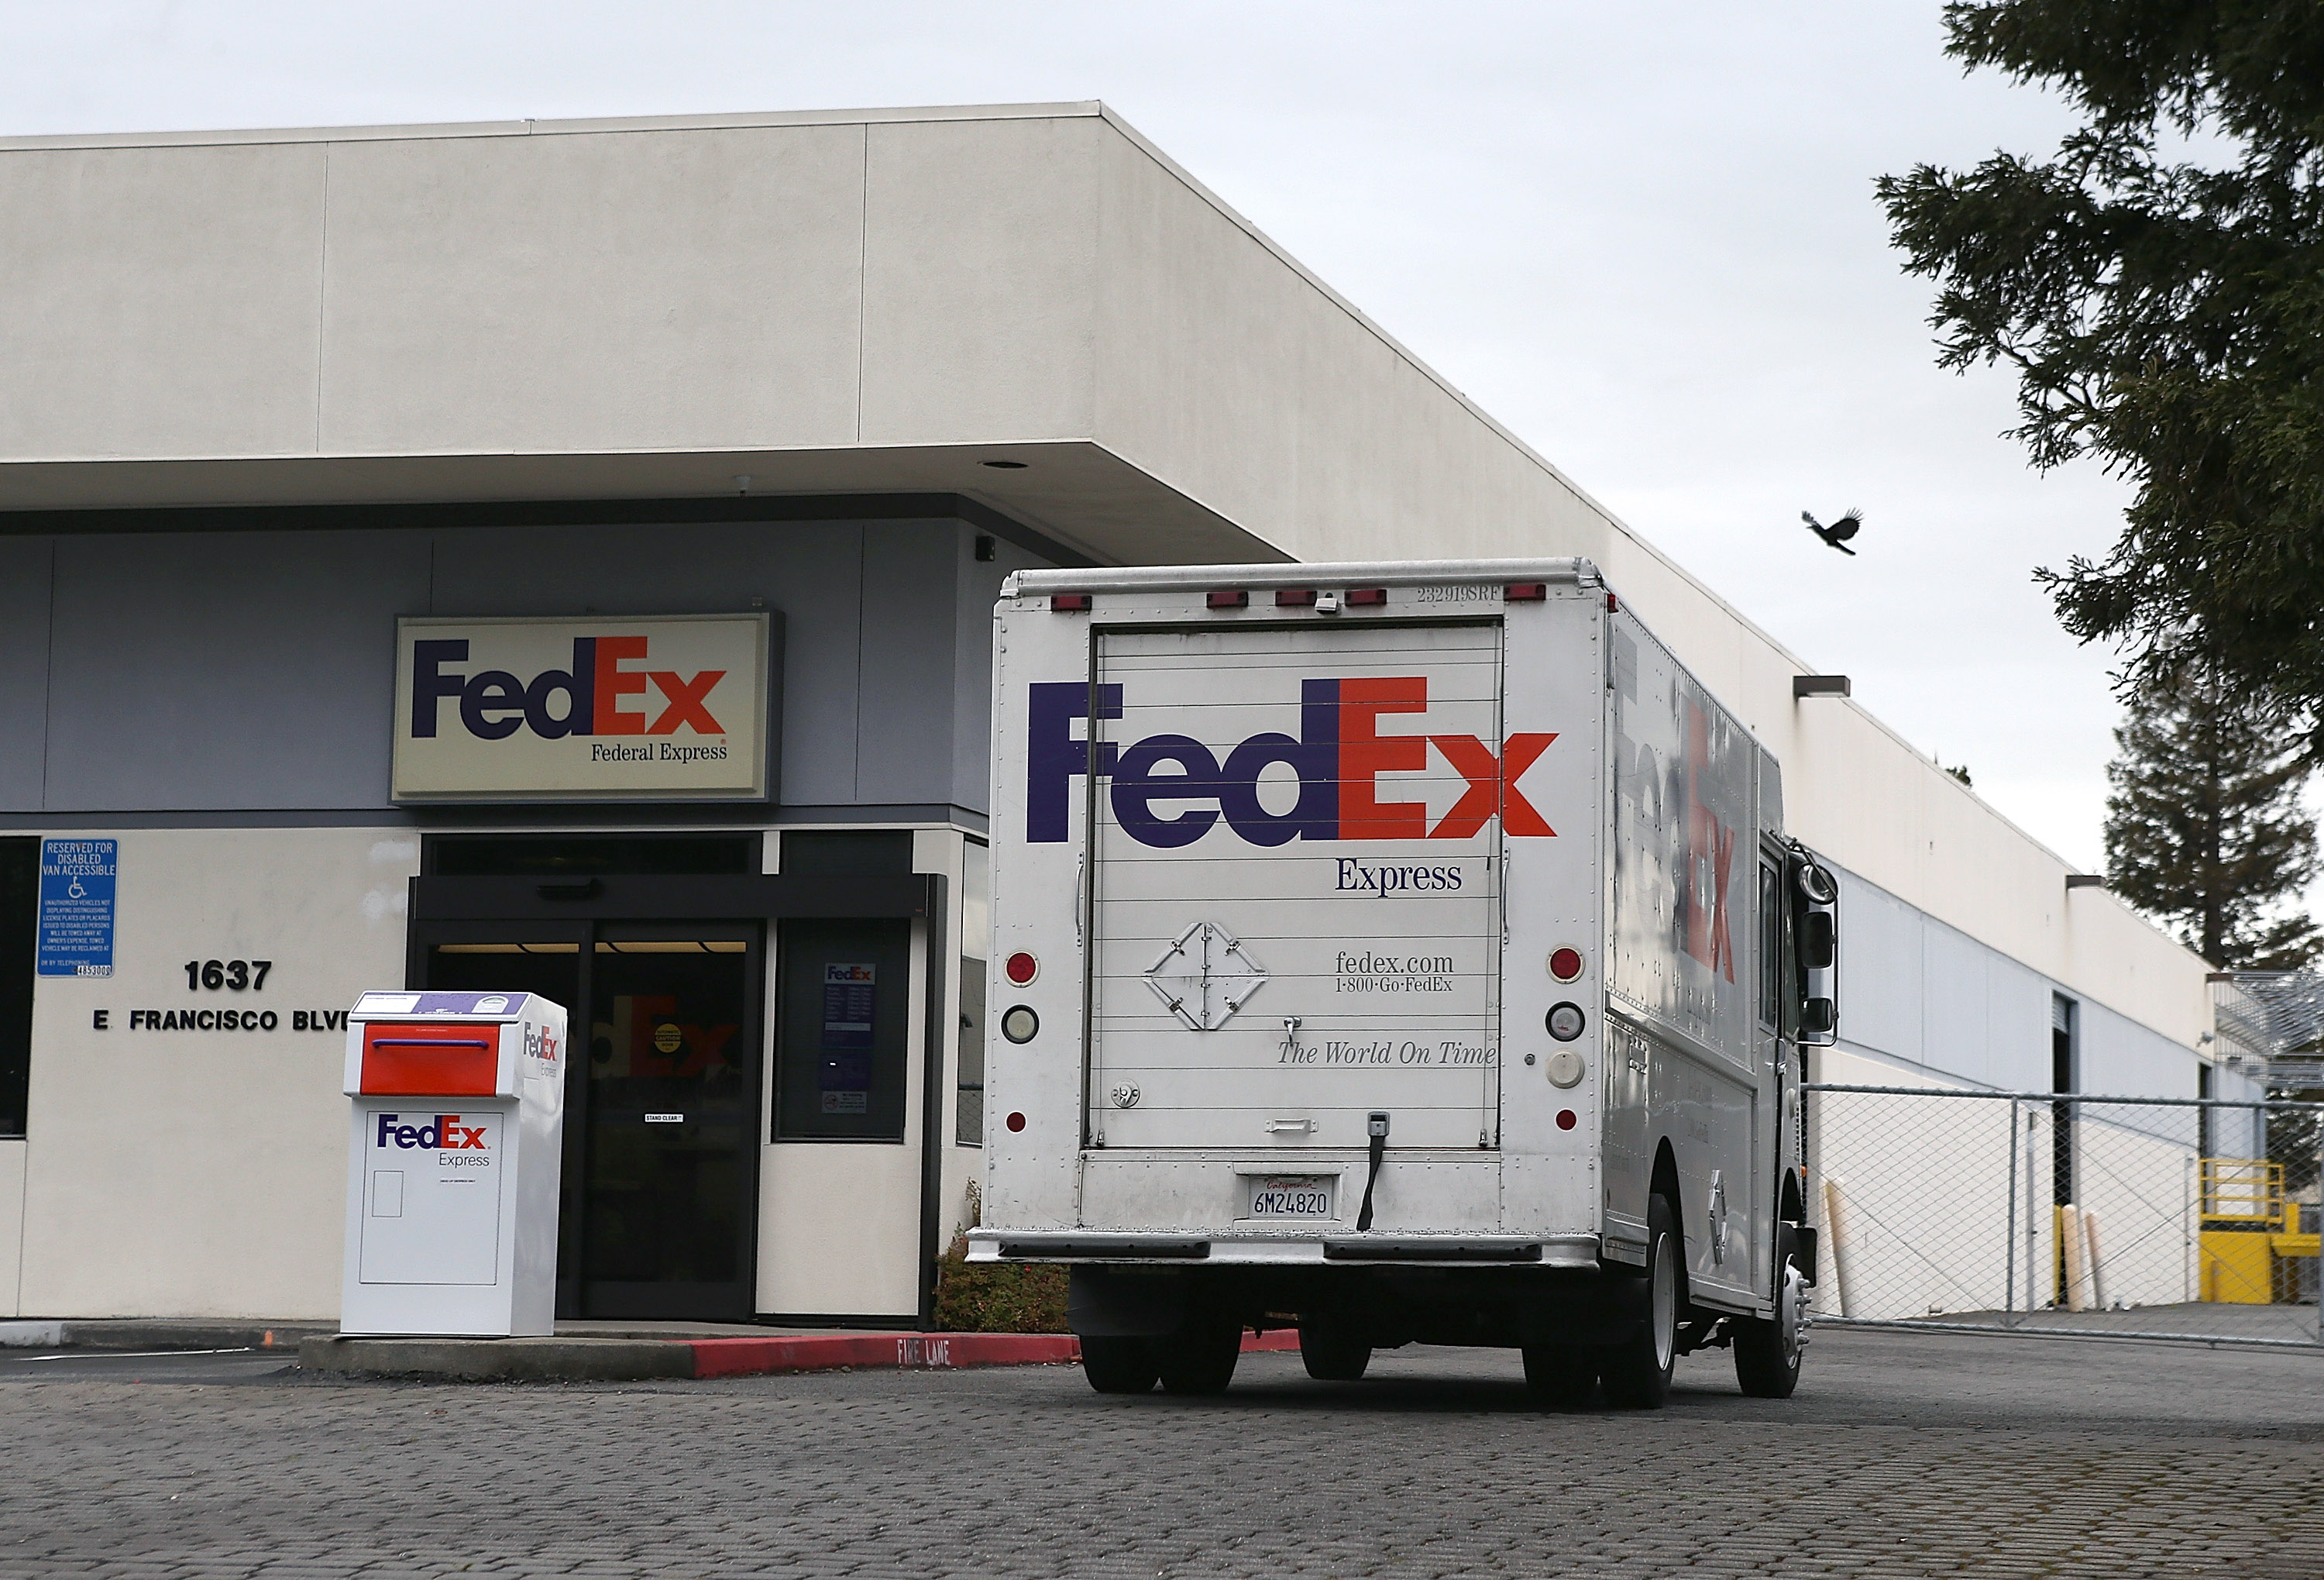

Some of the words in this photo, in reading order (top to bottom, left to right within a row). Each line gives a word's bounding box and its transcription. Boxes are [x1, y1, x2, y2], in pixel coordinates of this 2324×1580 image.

[411, 636, 727, 740] FedEx
[591, 744, 653, 762] Federal
[659, 742, 727, 763] Express
[1026, 676, 1560, 848] FedEx
[47, 842, 93, 853] RESERVED
[95, 842, 112, 853] FOR
[57, 854, 101, 865] DISABLED
[43, 865, 60, 876] VAN
[62, 865, 115, 876] ACCESSIBLE
[1335, 858, 1463, 897] Express
[1336, 951, 1454, 973] fedex.com
[184, 959, 272, 990] 1637
[827, 966, 871, 980] FedEx
[129, 1010, 278, 1031] FRANCISCO
[524, 1021, 558, 1062] FedEx
[1277, 1041, 1318, 1064] The
[1325, 1041, 1392, 1064] World
[1399, 1041, 1432, 1064] On
[1439, 1041, 1497, 1064] Time
[376, 1114, 487, 1149] FedEx
[439, 1152, 490, 1168] Express
[1267, 1179, 1317, 1192] California
[1254, 1193, 1327, 1213] 6M24820
[897, 1339, 920, 1365] FIRE
[925, 1340, 951, 1365] LANE
